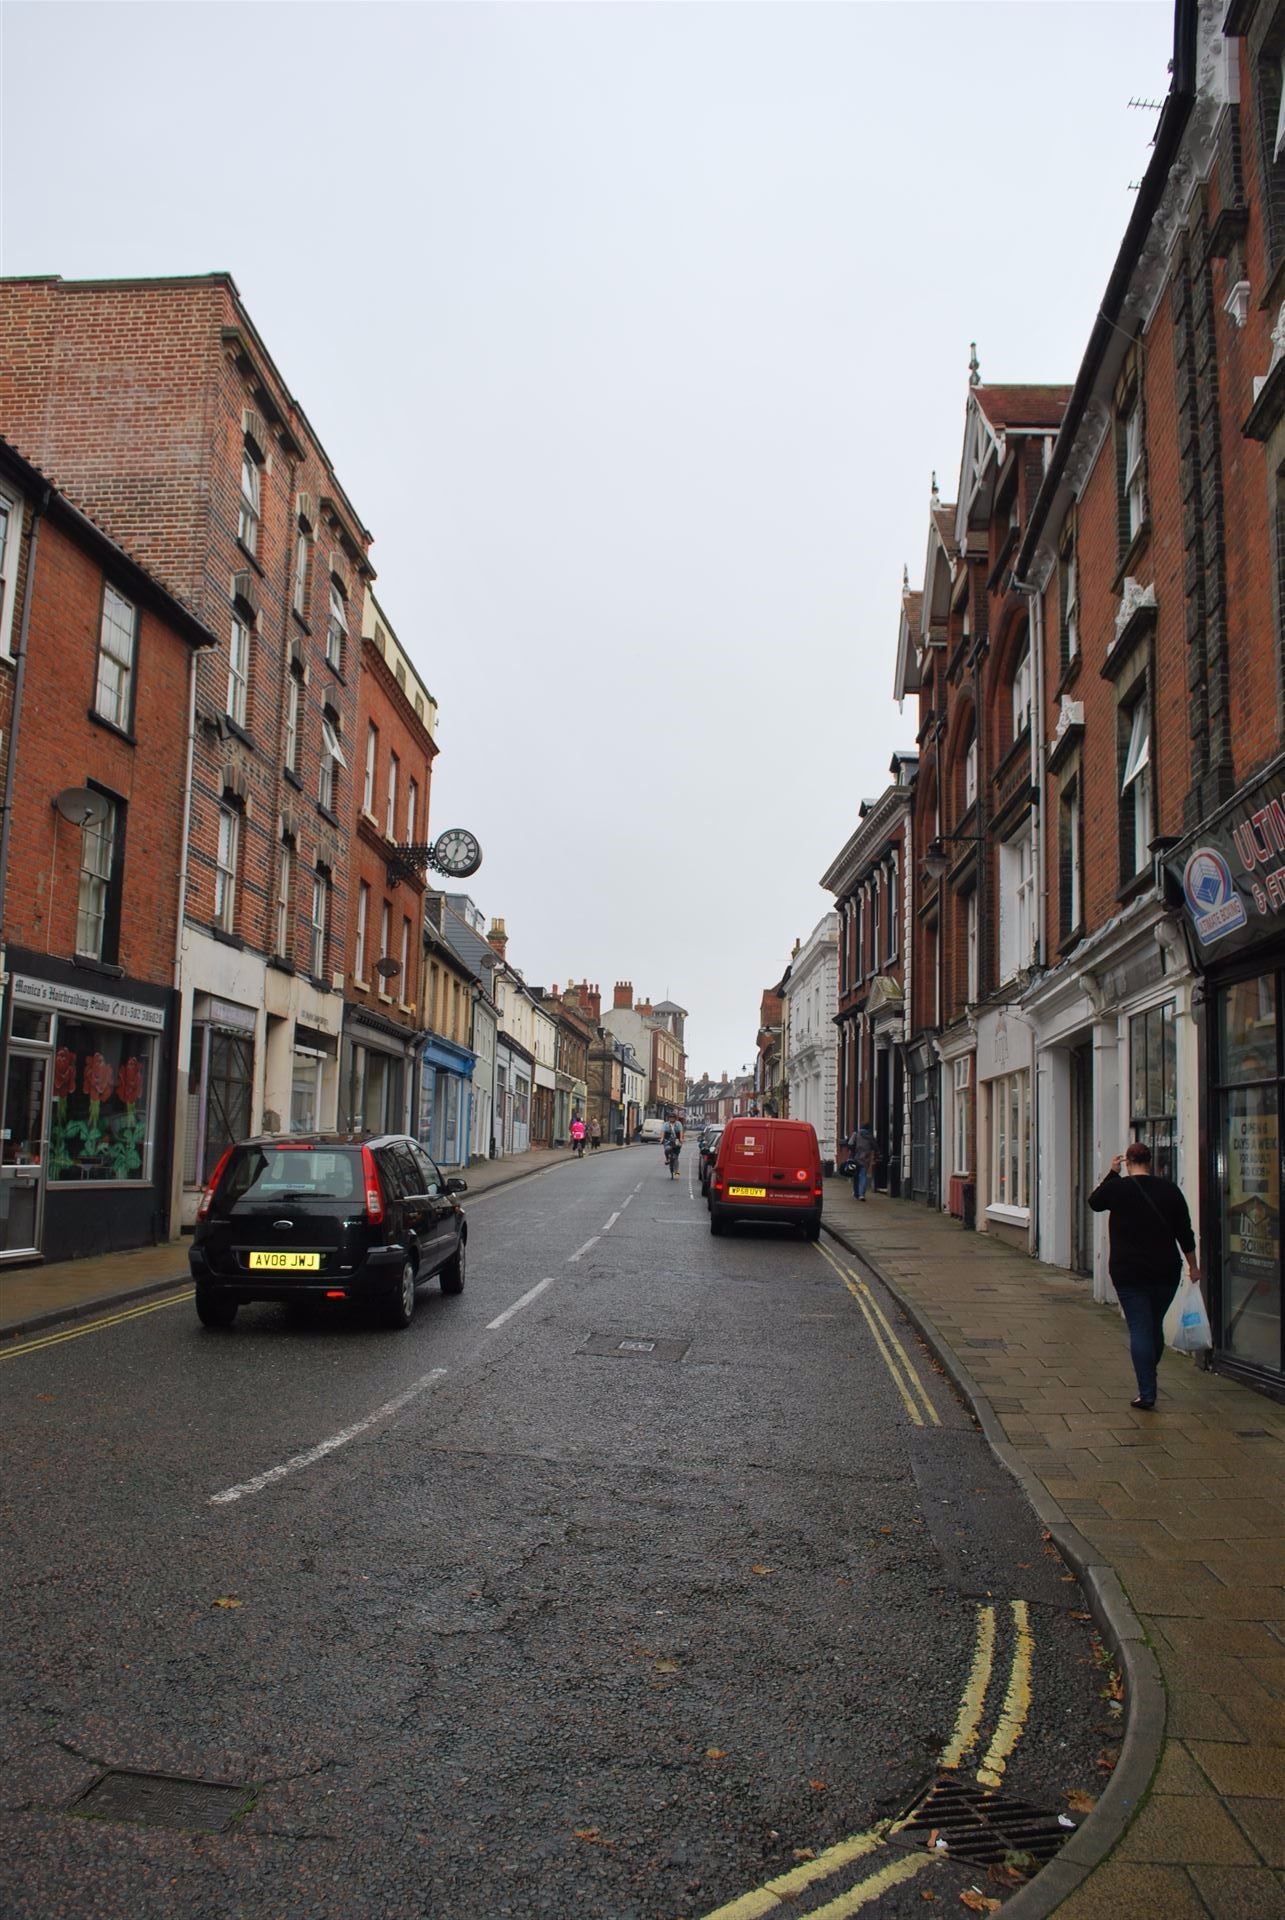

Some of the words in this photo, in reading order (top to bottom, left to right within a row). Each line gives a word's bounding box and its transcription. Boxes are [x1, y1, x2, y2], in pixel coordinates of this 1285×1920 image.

[1251, 883, 1266, 914] &
[15, 979, 47, 998] Monica's
[48, 986, 89, 1010] Hairbraiding
[90, 996, 110, 1013] Studio
[255, 1254, 287, 1266] AV08
[290, 1255, 315, 1267] JWJ
